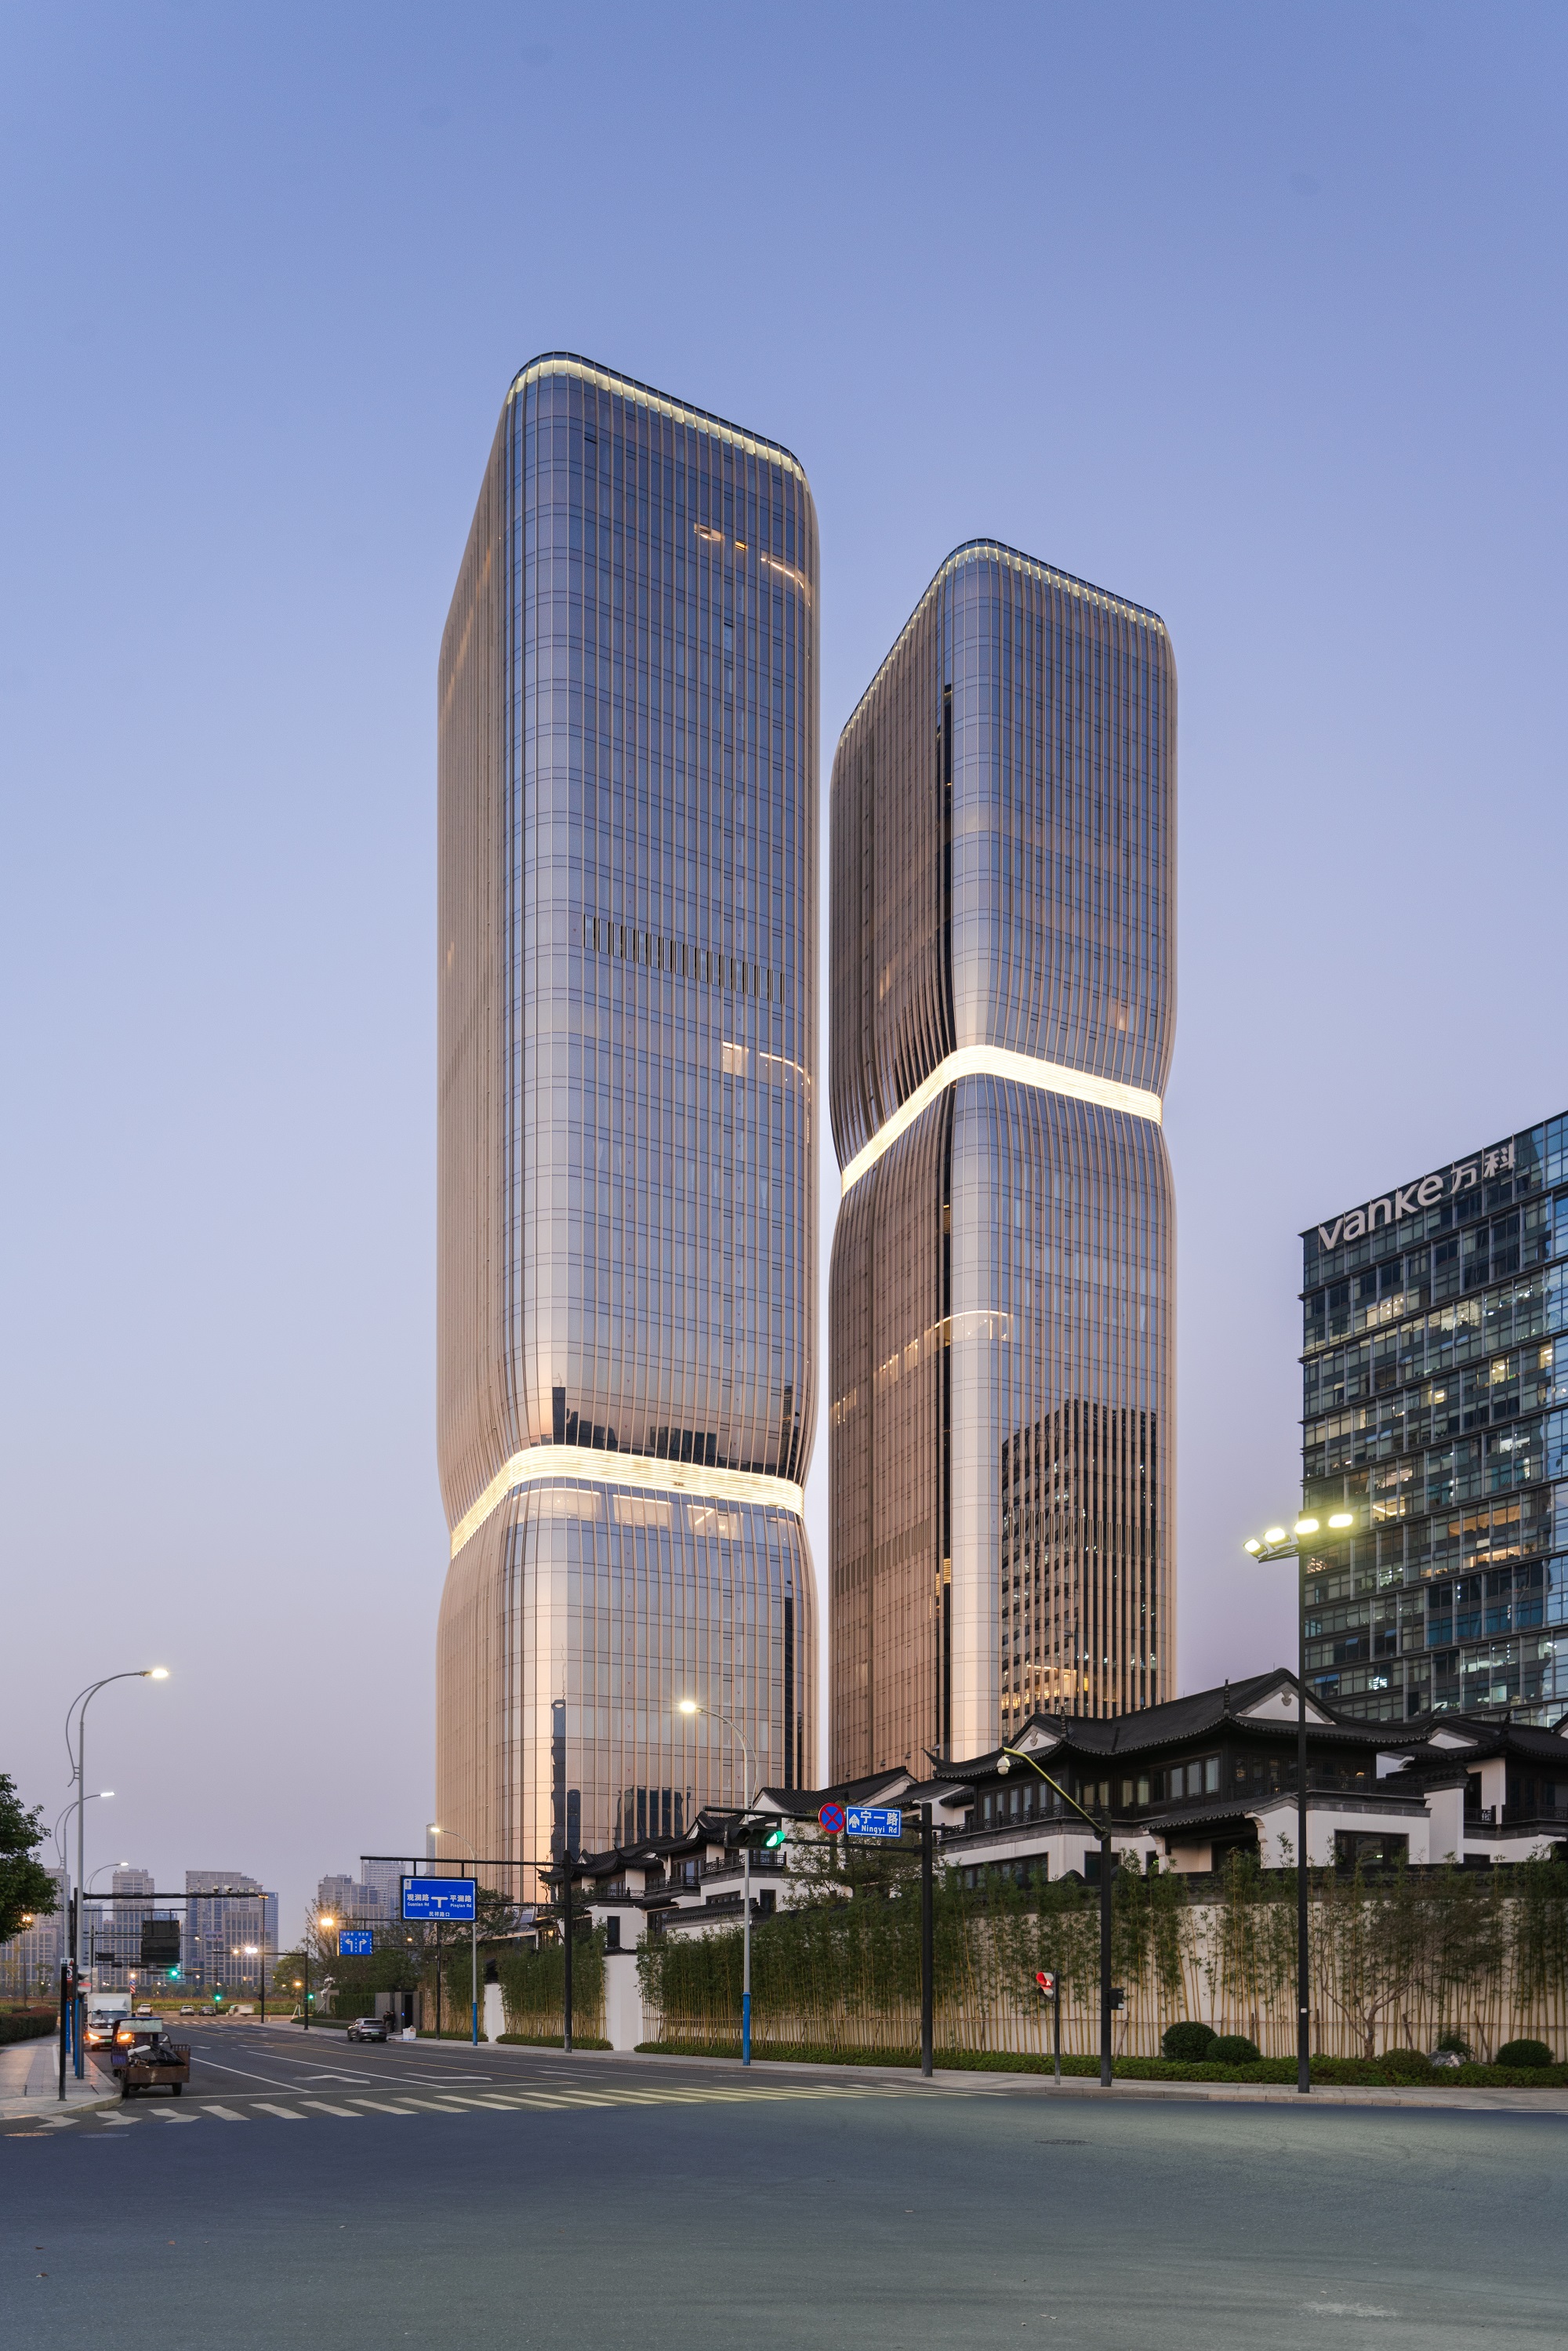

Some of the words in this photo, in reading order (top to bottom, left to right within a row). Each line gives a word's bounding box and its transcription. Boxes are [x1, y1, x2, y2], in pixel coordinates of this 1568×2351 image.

[1318, 1175, 1444, 1251] vanke
[1450, 1143, 1516, 1194] 万科
[860, 1810, 898, 1826] 宁一路
[861, 1825, 885, 1834] Ningyi
